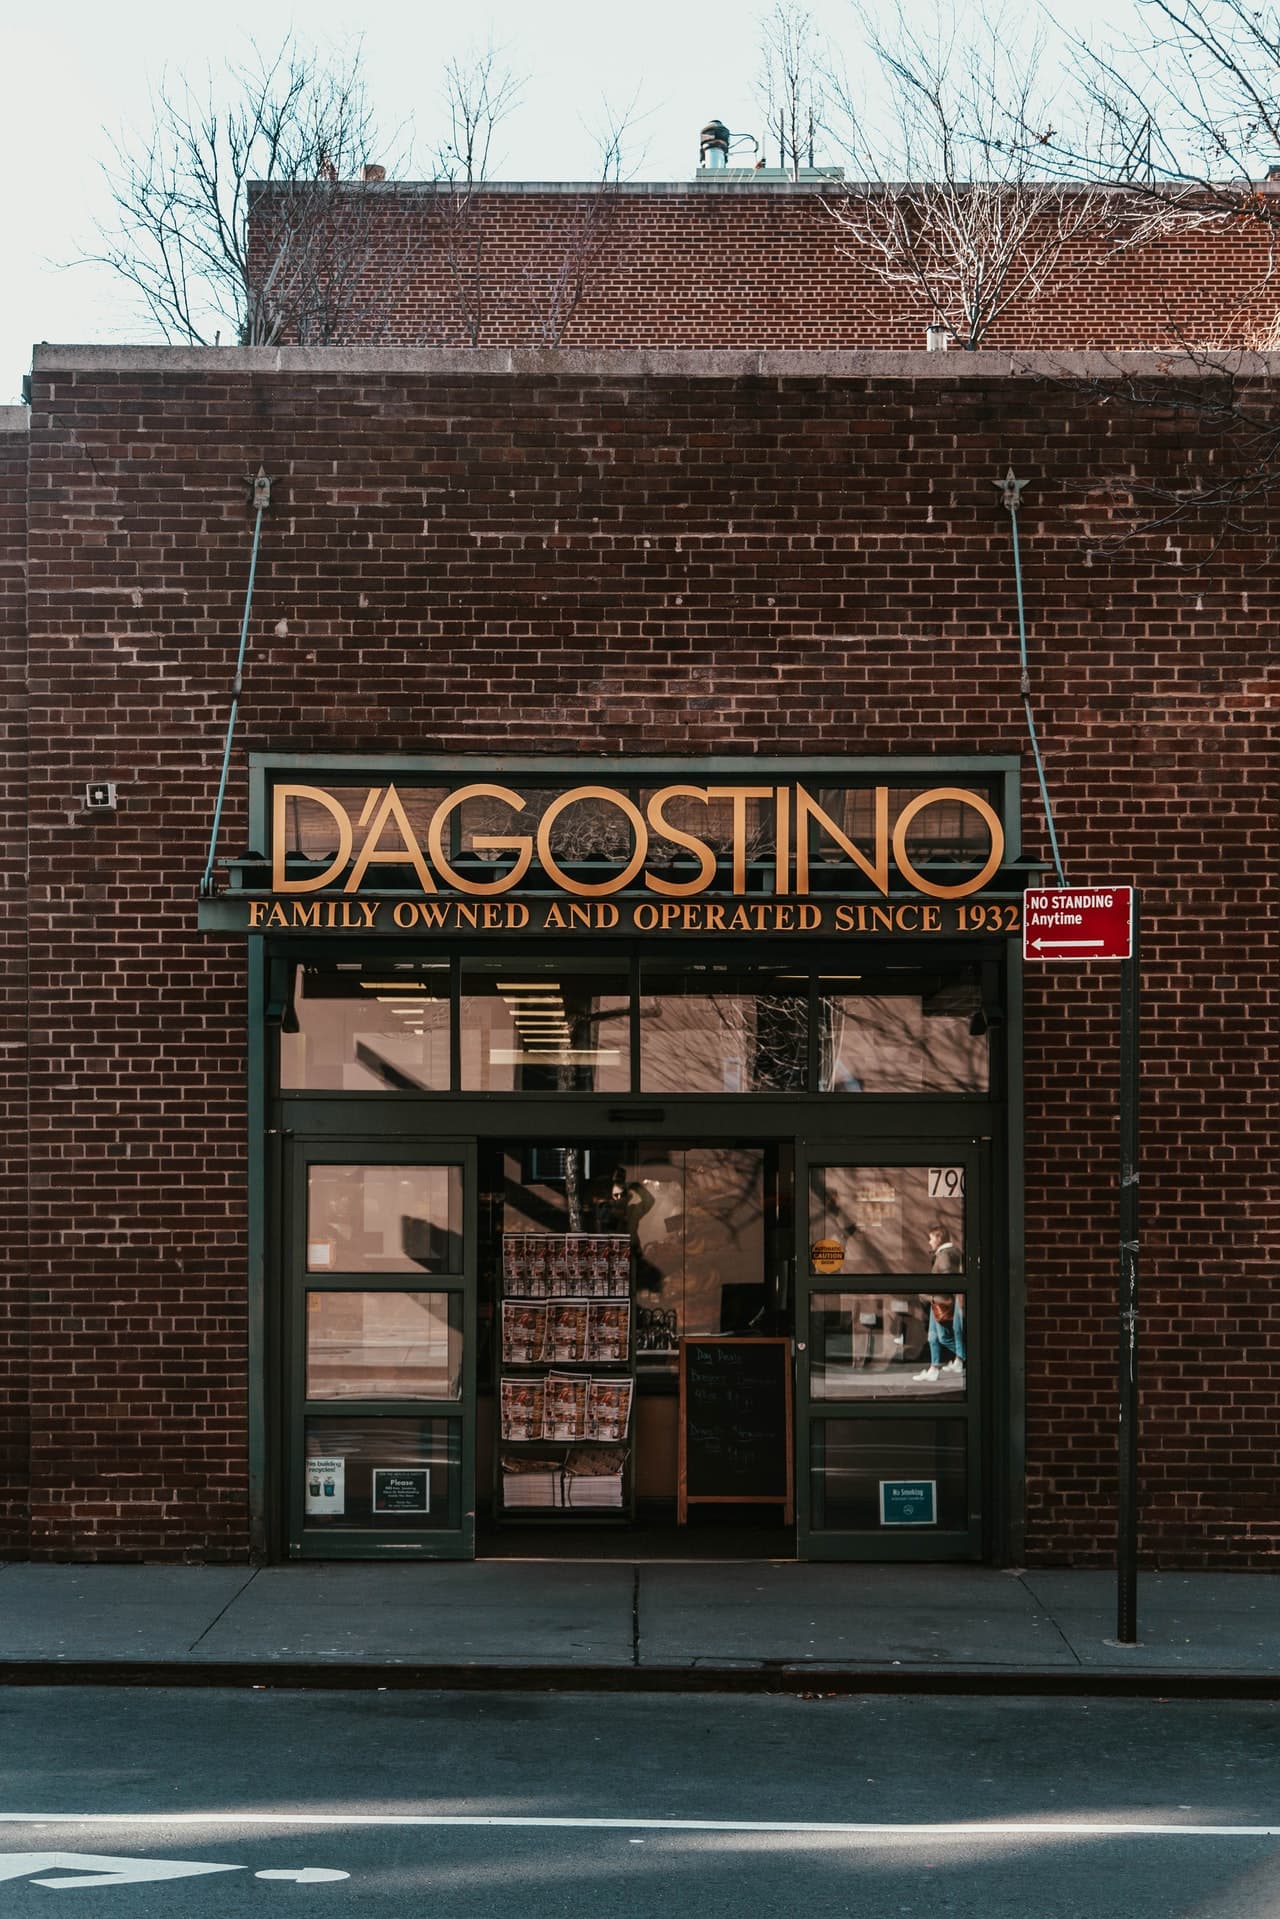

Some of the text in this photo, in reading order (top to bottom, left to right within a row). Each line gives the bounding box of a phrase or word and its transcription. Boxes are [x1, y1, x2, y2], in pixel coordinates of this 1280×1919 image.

[272, 781, 1005, 899] D'AGOSTINO
[1031, 895, 1114, 909] NO STANDING
[247, 901, 1021, 932] FAMILY OWNED AND OPERATED SINCE 1932
[1031, 912, 1083, 928] Anytime
[900, 1488, 924, 1497] Smoking
